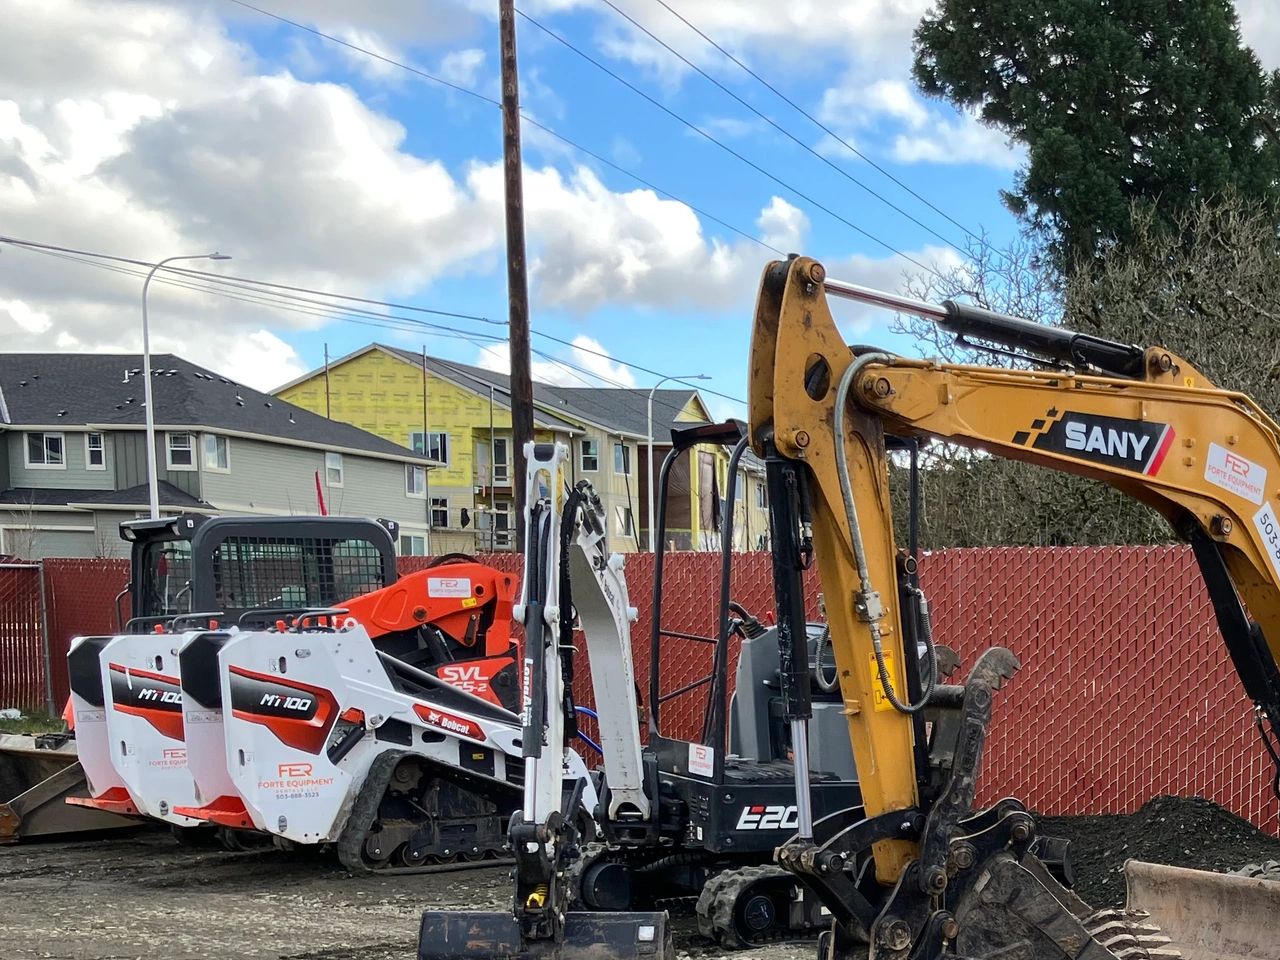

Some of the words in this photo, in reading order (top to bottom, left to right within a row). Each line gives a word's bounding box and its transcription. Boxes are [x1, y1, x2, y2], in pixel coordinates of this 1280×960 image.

[1065, 421, 1150, 461] SANY
[1225, 453, 1250, 478] FER
[1208, 464, 1227, 480] FORTE
[1228, 474, 1262, 496] EQUIPMENT
[442, 667, 489, 681] SVL
[260, 693, 312, 711] MT100
[441, 717, 470, 734] Bobcat
[278, 763, 313, 778] FER
[258, 780, 284, 789] FORTE
[287, 778, 333, 788] EQUIPMENT
